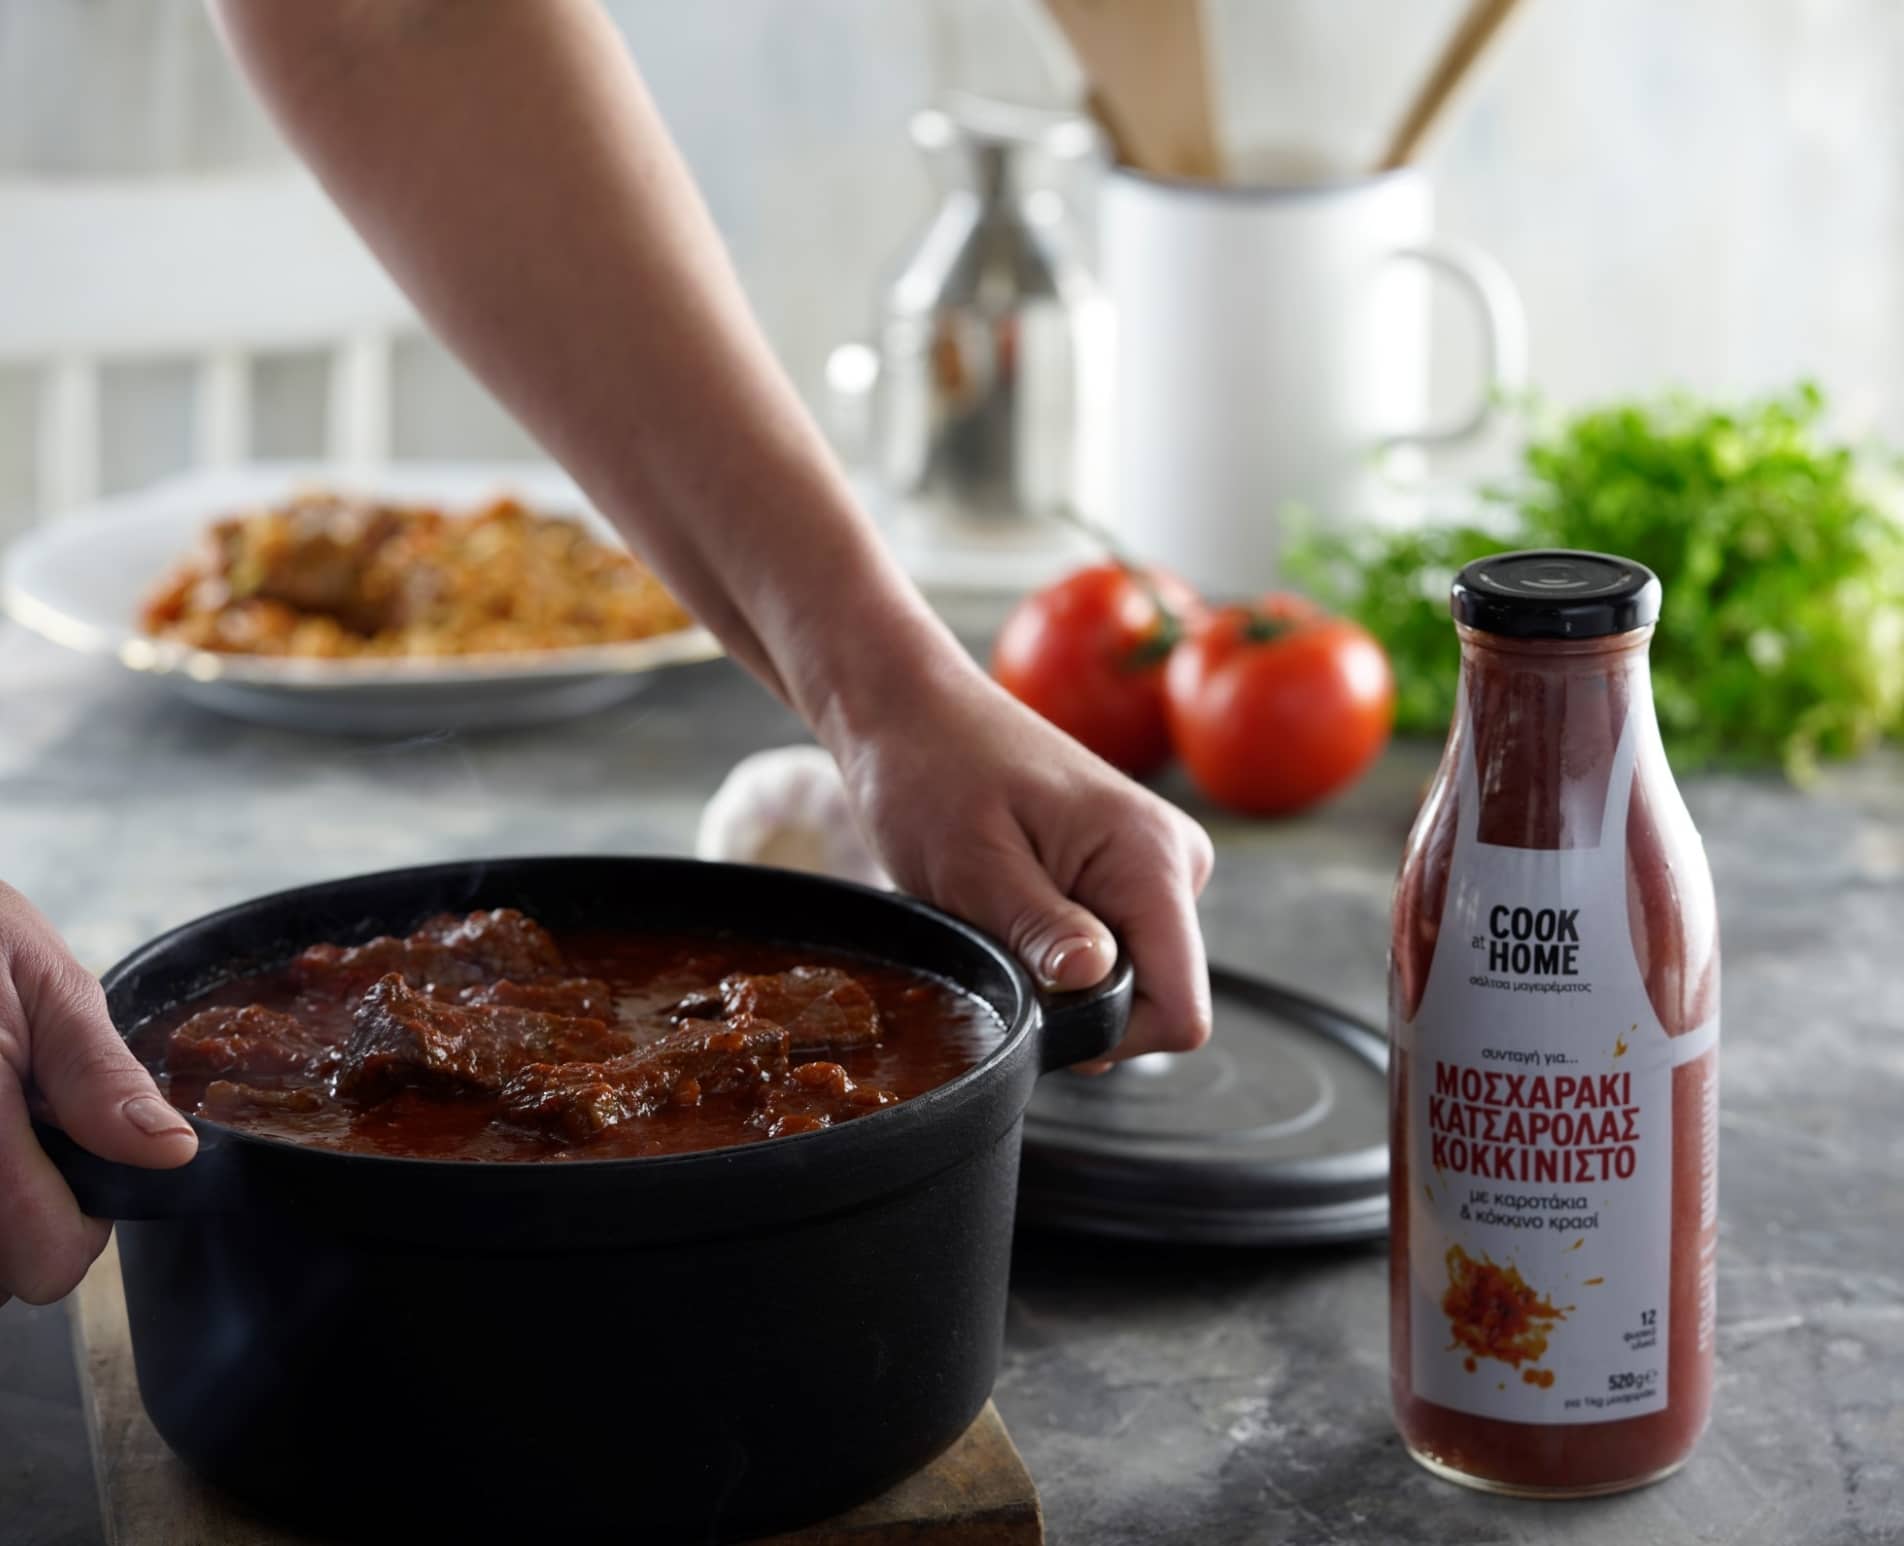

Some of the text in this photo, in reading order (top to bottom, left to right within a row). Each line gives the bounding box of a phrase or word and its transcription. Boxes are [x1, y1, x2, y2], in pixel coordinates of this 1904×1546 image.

[1489, 904, 1580, 942] COOK
[1471, 935, 1486, 950] at
[1488, 940, 1580, 975] HOME
[1469, 975, 1593, 995] σάλτσα μαγειρέματος
[1481, 1047, 1579, 1065] συνταγή για...
[1435, 1060, 1632, 1110] ΜΟΣΧΑΡΑΚΙ
[1428, 1095, 1641, 1147] ΚΑΤΣΑΡΟΛΑΣ
[1431, 1131, 1637, 1184] ΚΟΚΚΙΝΙΣΤΟ
[1469, 1189, 1588, 1212] με καροτάκια
[1459, 1203, 1600, 1232] & κόκκινο κρασί
[1641, 1308, 1657, 1327] 12
